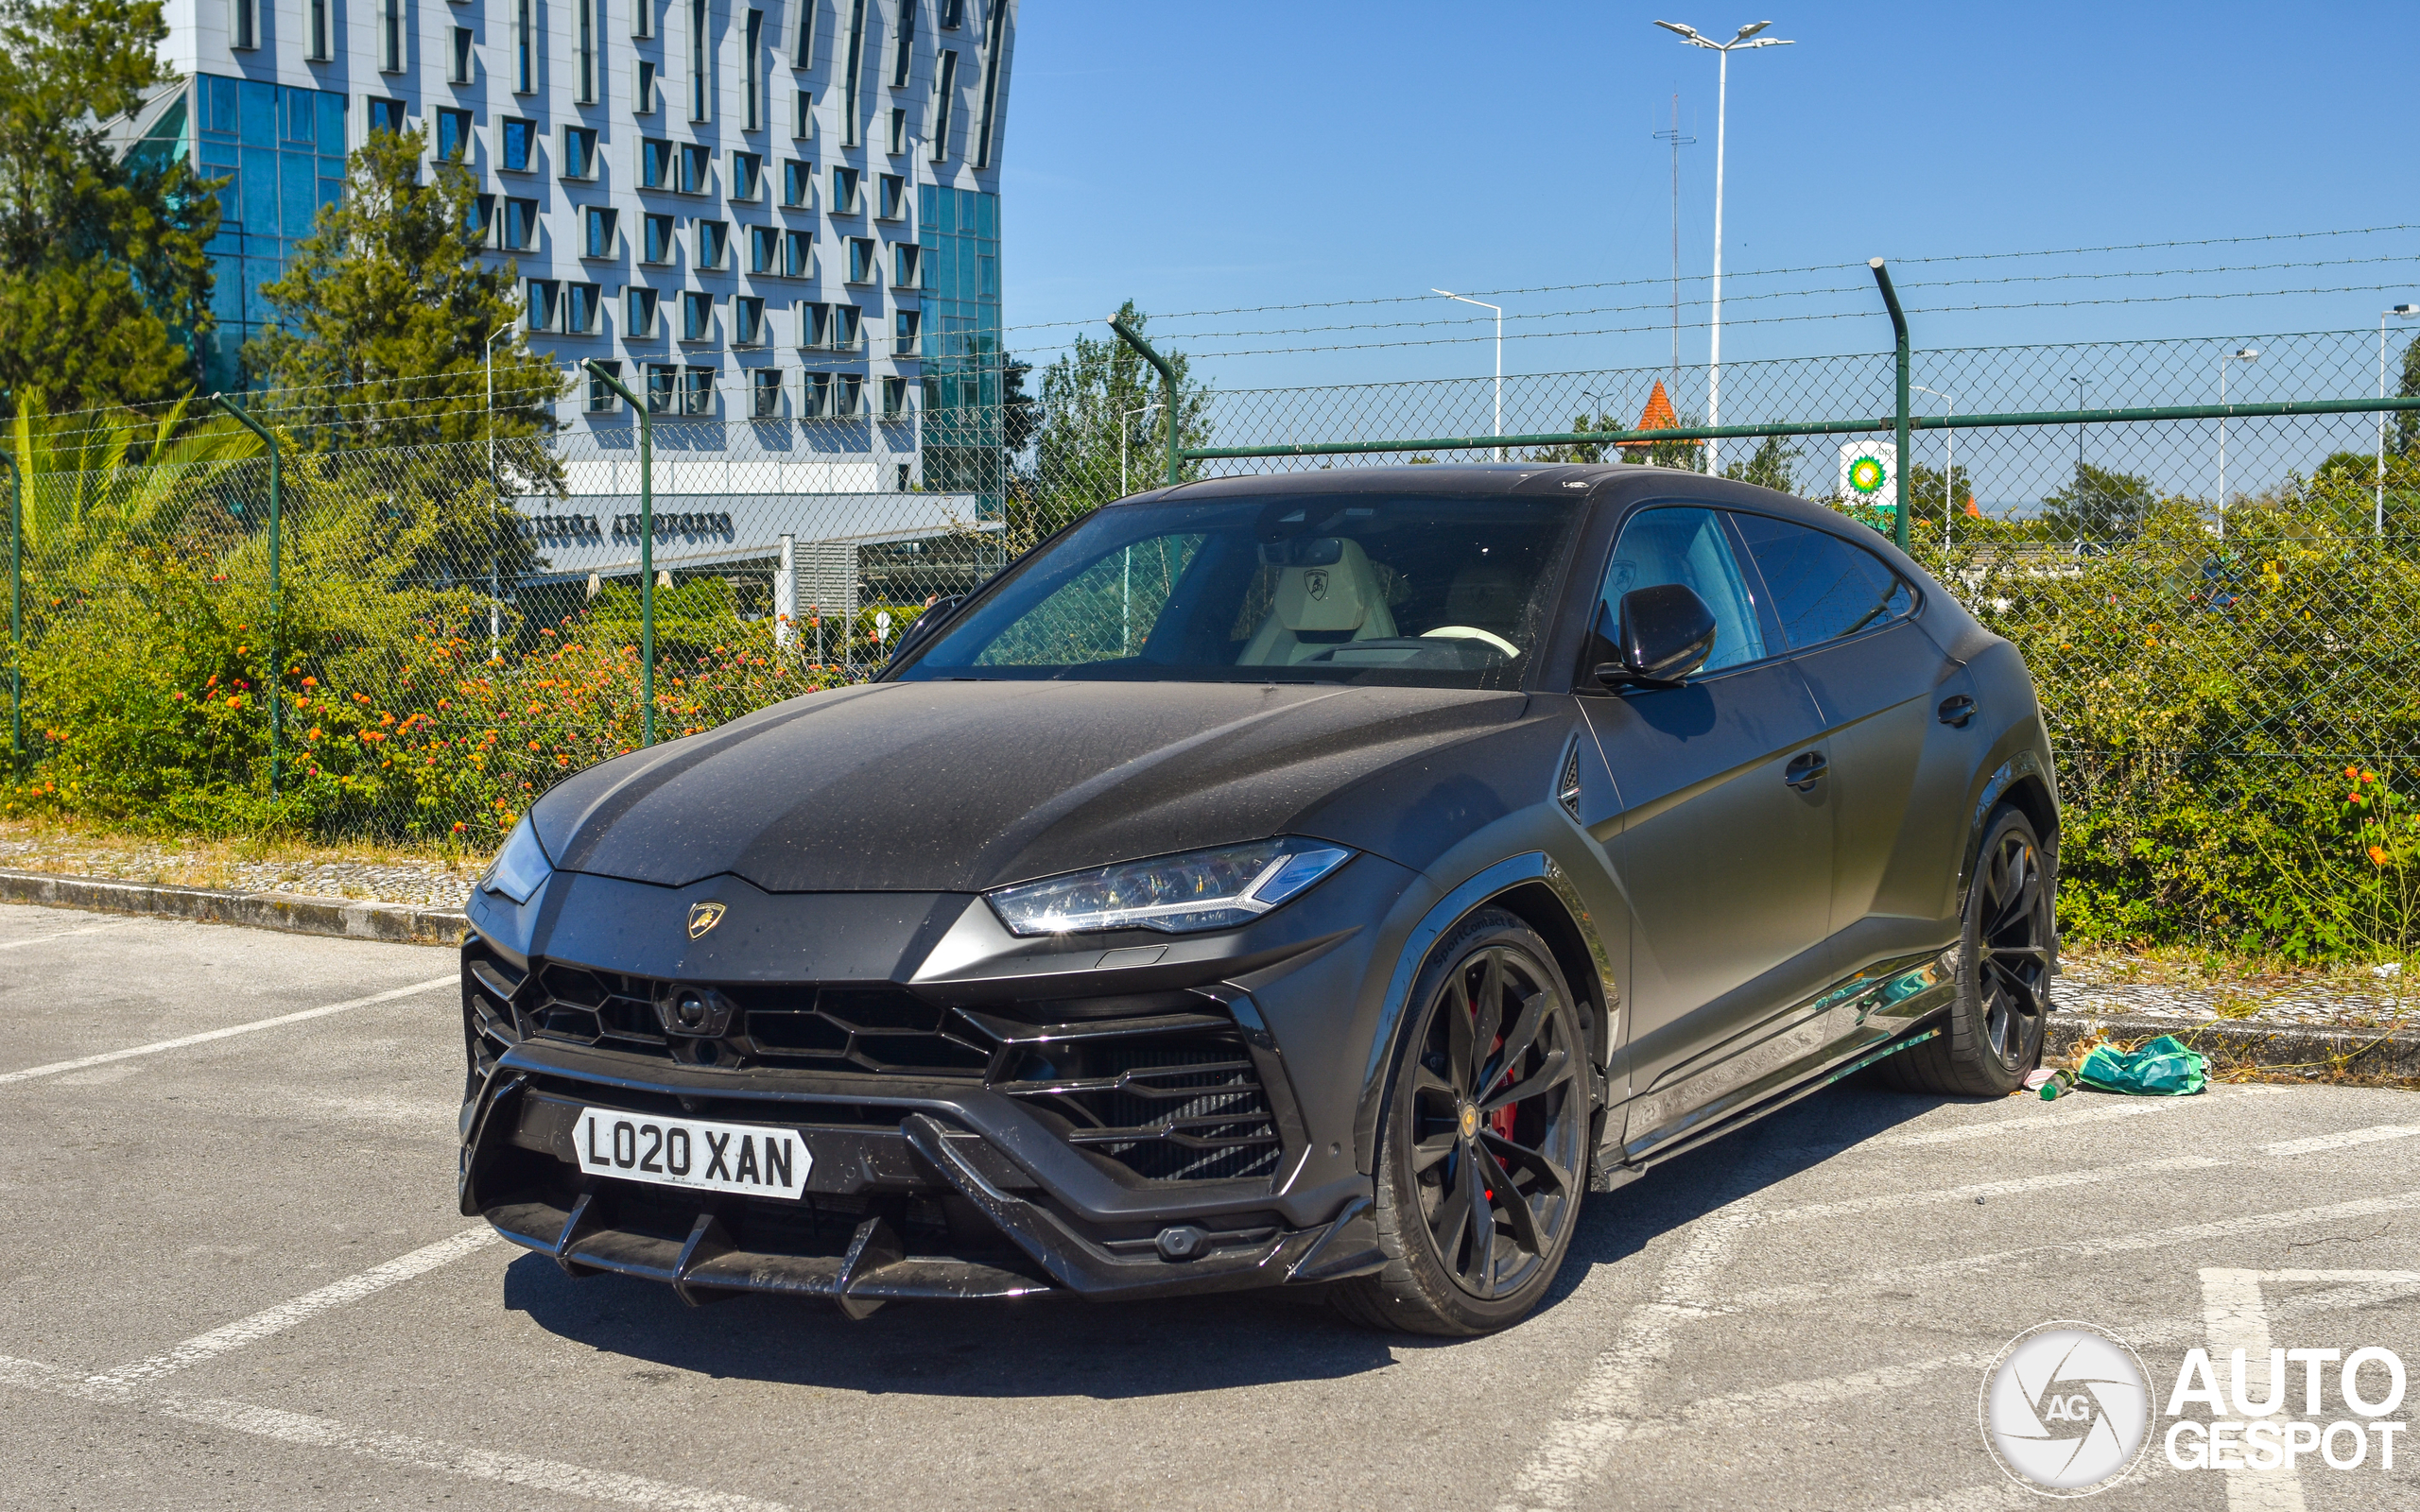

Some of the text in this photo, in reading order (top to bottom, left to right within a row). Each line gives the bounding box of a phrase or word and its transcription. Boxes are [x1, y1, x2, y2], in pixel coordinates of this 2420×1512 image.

[1878, 448, 1891, 457] bp
[1433, 917, 1516, 969] SportContact 6
[588, 1116, 793, 1188] LO20 XAN
